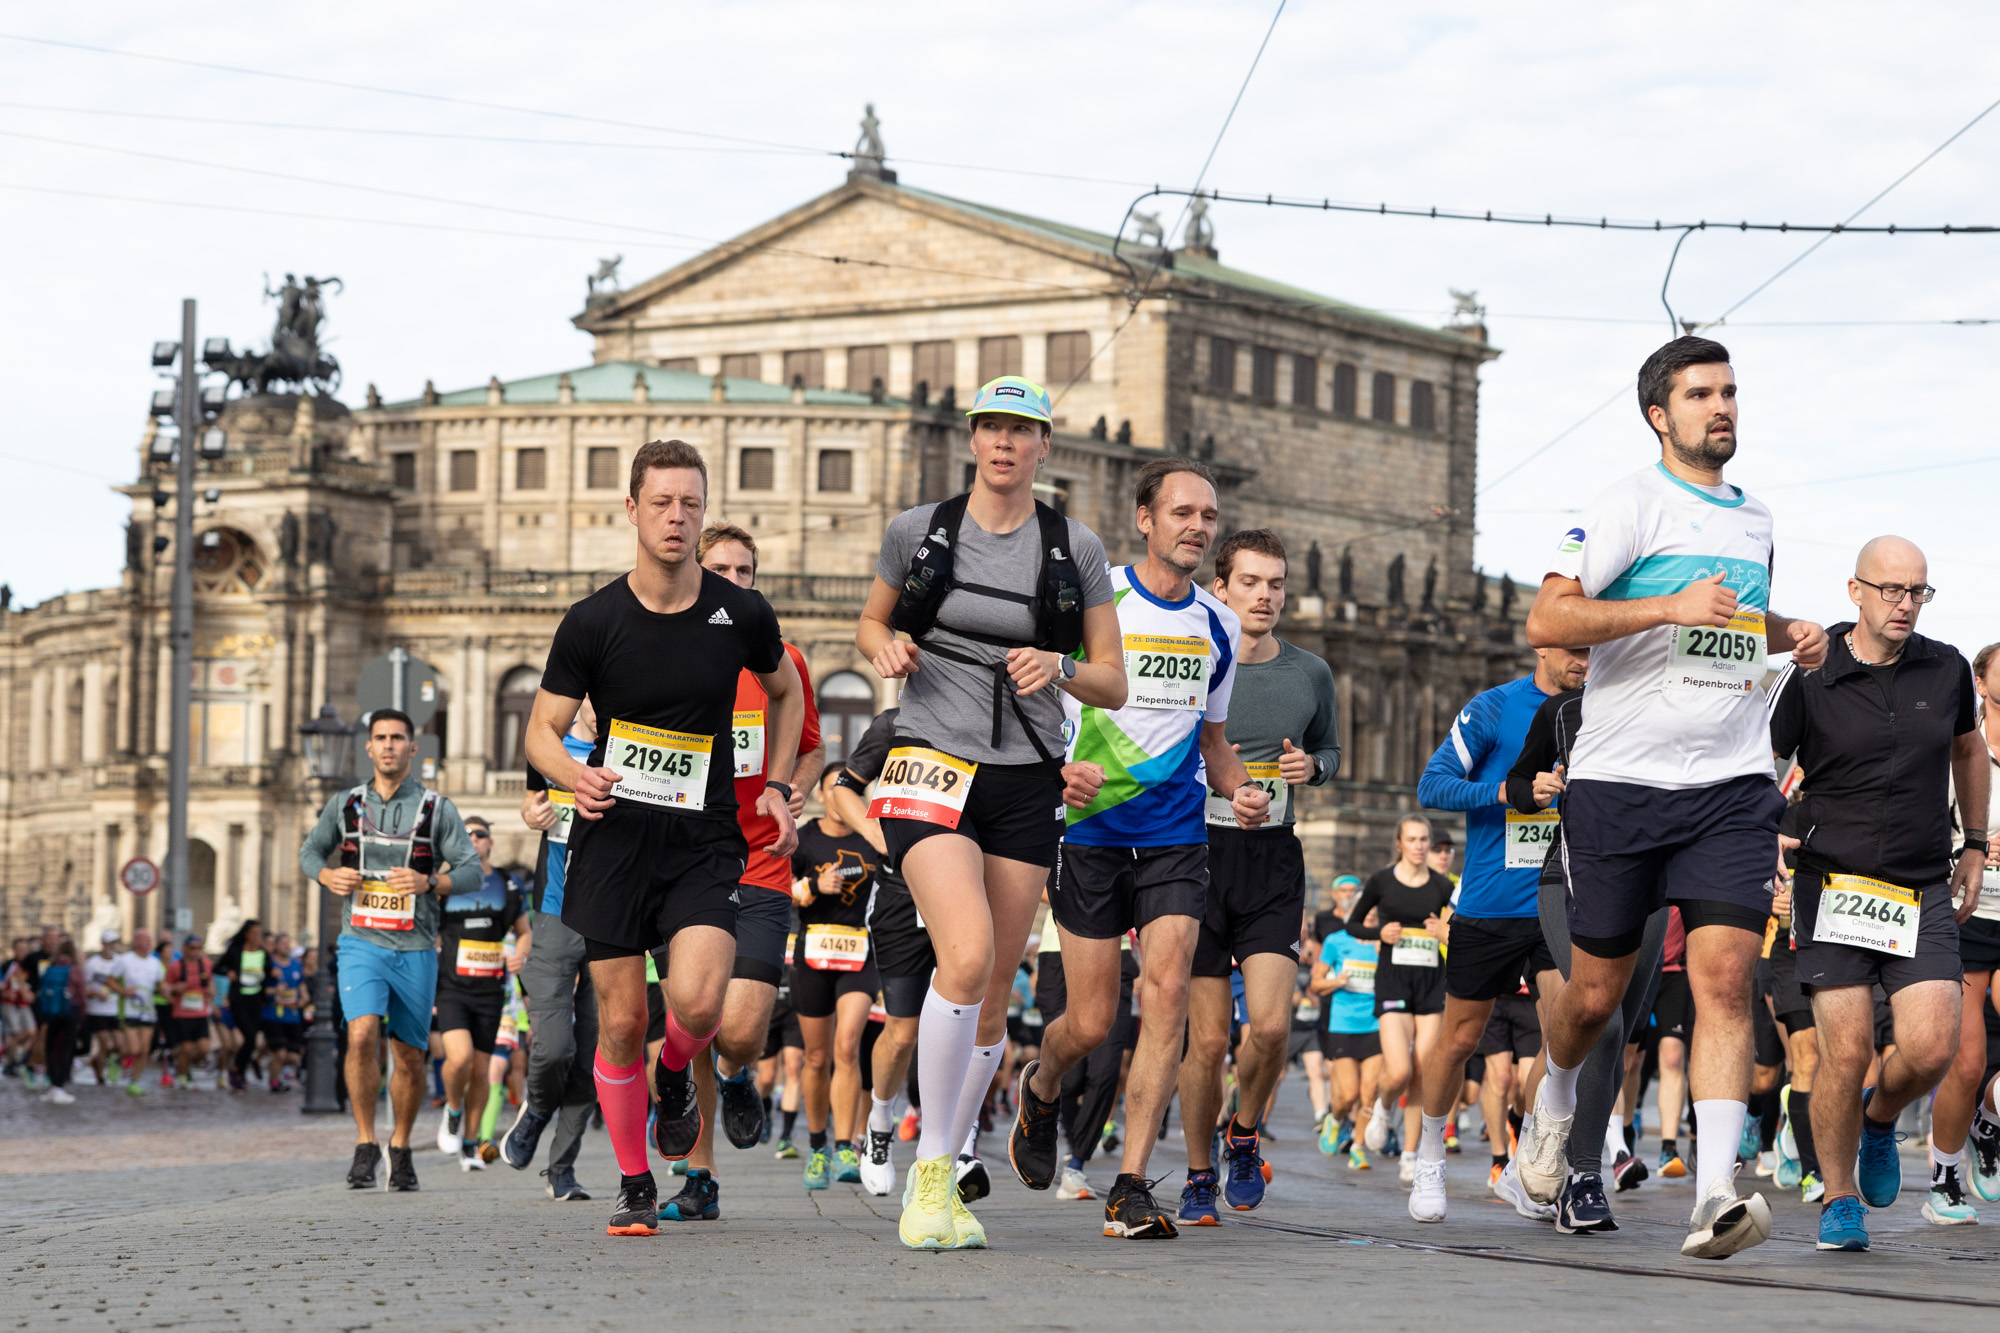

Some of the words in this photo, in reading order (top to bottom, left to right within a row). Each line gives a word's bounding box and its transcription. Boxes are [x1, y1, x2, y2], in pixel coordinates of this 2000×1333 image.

[708, 617, 733, 625] adidas
[1146, 638, 1204, 646] DRESDEN-MARATHON
[1686, 630, 1756, 662] 22059
[1138, 654, 1201, 680] 22032
[1712, 661, 1736, 670] Adrian
[1162, 680, 1180, 688] Gerrit
[1683, 676, 1743, 690] Piepenbrock
[1136, 696, 1188, 706] Piepenbrock
[632, 726, 704, 744] DRESDEN-MARATHON
[622, 744, 693, 776] 21945
[640, 772, 671, 784] Thomas
[884, 760, 958, 792] 40049
[616, 784, 674, 802] Piepenbrock
[900, 788, 918, 796] Nina
[892, 806, 929, 818] Sparkasse
[1210, 813, 1236, 822] Piepen
[1518, 825, 1557, 842] 234
[1844, 877, 1912, 898] DRESDEN-MARATHON
[362, 894, 404, 910] 40281
[1832, 893, 1906, 926] 22464
[1852, 918, 1885, 931] Christian
[820, 938, 856, 952] 41419
[1830, 931, 1886, 948] Piepenbrock
